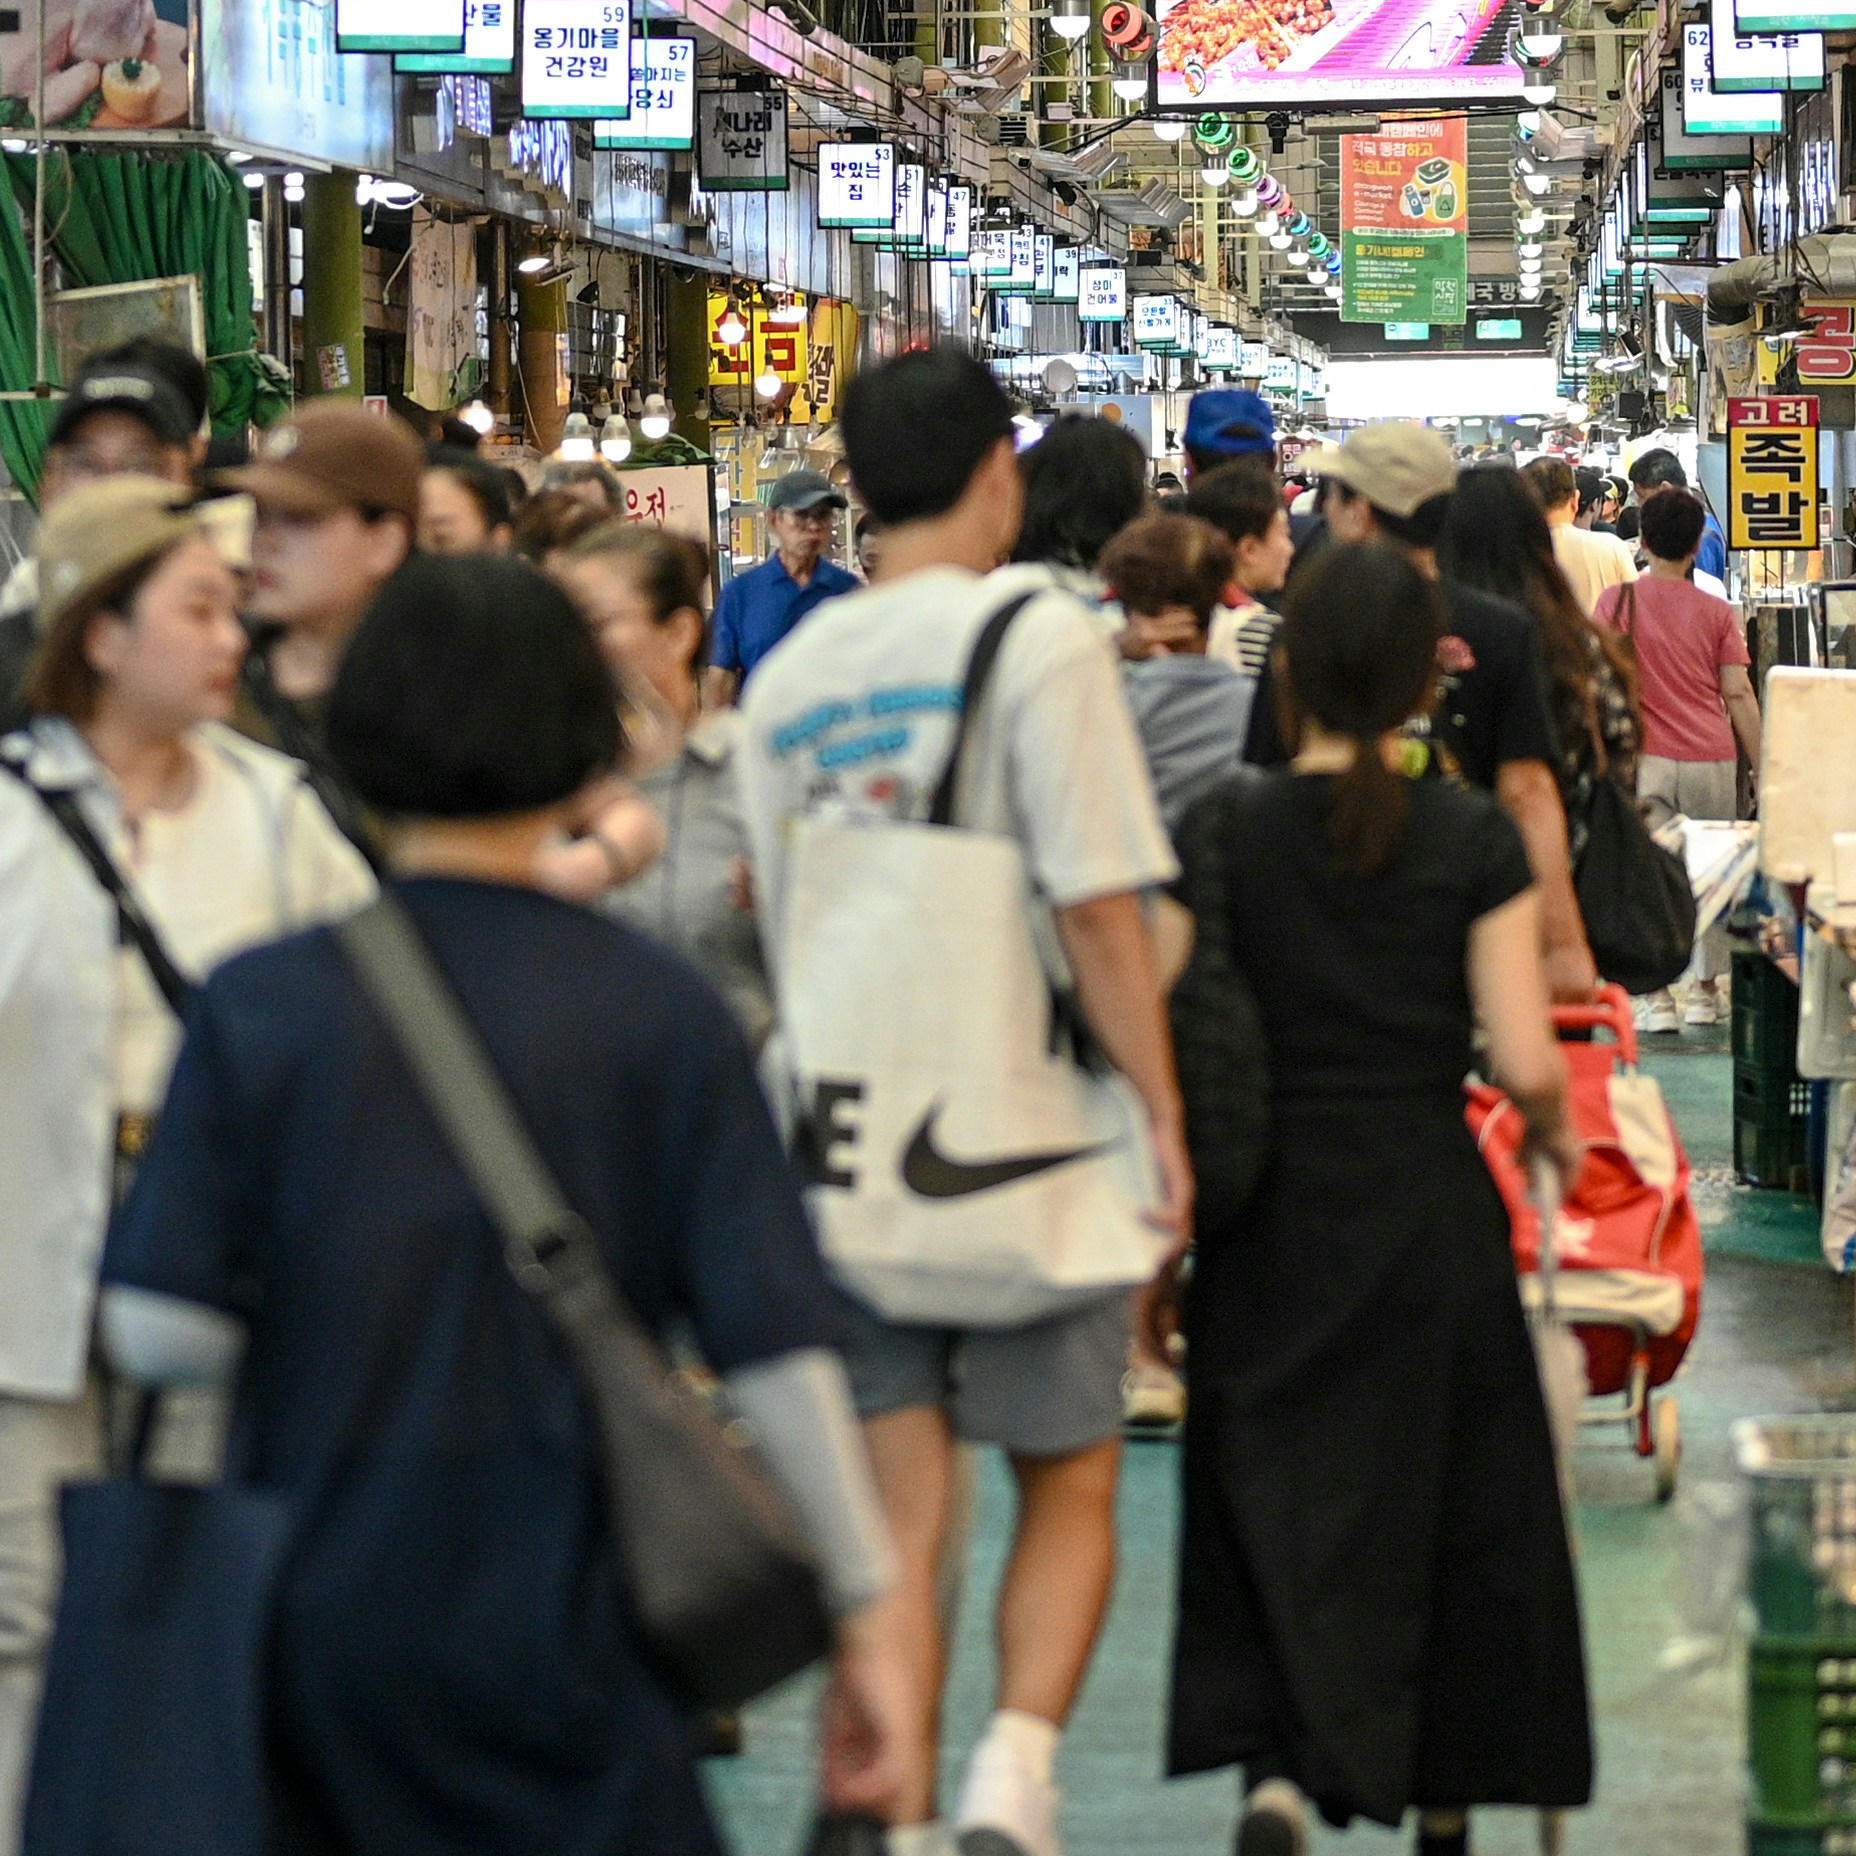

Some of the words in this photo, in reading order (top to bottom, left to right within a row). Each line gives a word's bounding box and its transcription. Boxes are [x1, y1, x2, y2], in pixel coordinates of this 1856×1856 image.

[603, 7, 624, 22] 59
[534, 27, 619, 49] 옹기마을
[1688, 31, 1709, 45] 62
[669, 46, 688, 60] 57
[546, 56, 607, 77] 건강원
[1664, 74, 1682, 89] 60
[631, 89, 673, 108] 당쇠
[764, 96, 782, 110] 55
[724, 138, 763, 158] 수산
[875, 149, 890, 160] 53
[831, 161, 880, 179] 맛있는
[1353, 159, 1402, 175] 있습니다
[849, 184, 863, 200] 집
[953, 192, 966, 201] 47
[1065, 250, 1076, 258] 39
[1736, 400, 1811, 428] 고려
[1741, 431, 1809, 542] 족발
